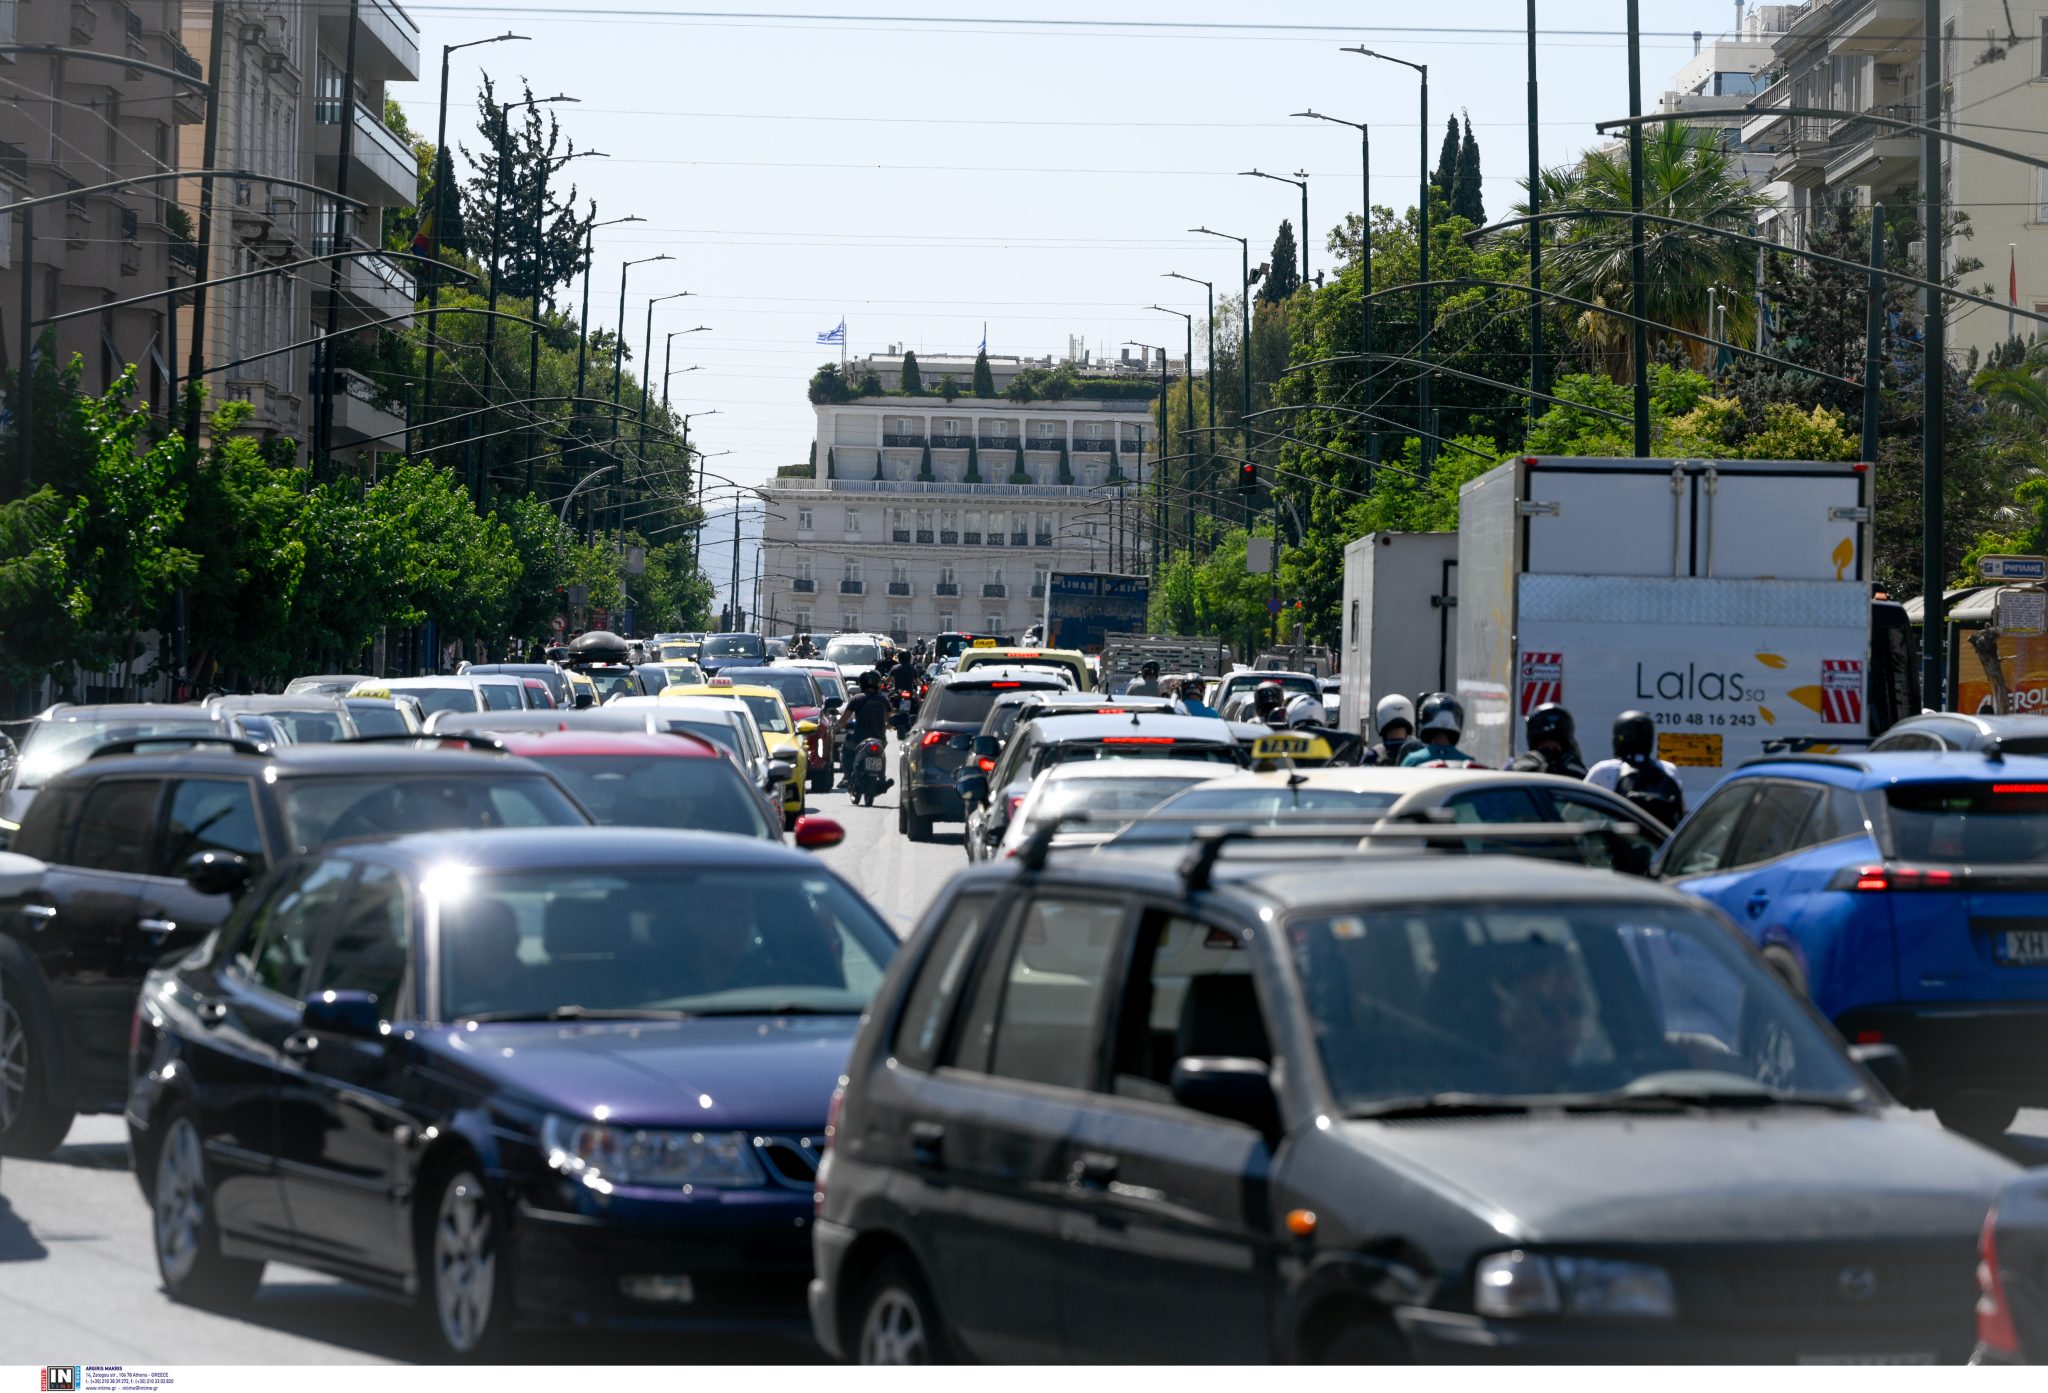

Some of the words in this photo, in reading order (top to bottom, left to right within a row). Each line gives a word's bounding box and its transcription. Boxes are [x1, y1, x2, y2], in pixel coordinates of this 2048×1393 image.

[1636, 662, 1744, 701] Lalas
[1655, 712, 1682, 725] 210
[1685, 713, 1704, 726] 48
[1709, 714, 1726, 726] 16
[1729, 714, 1756, 727] 243
